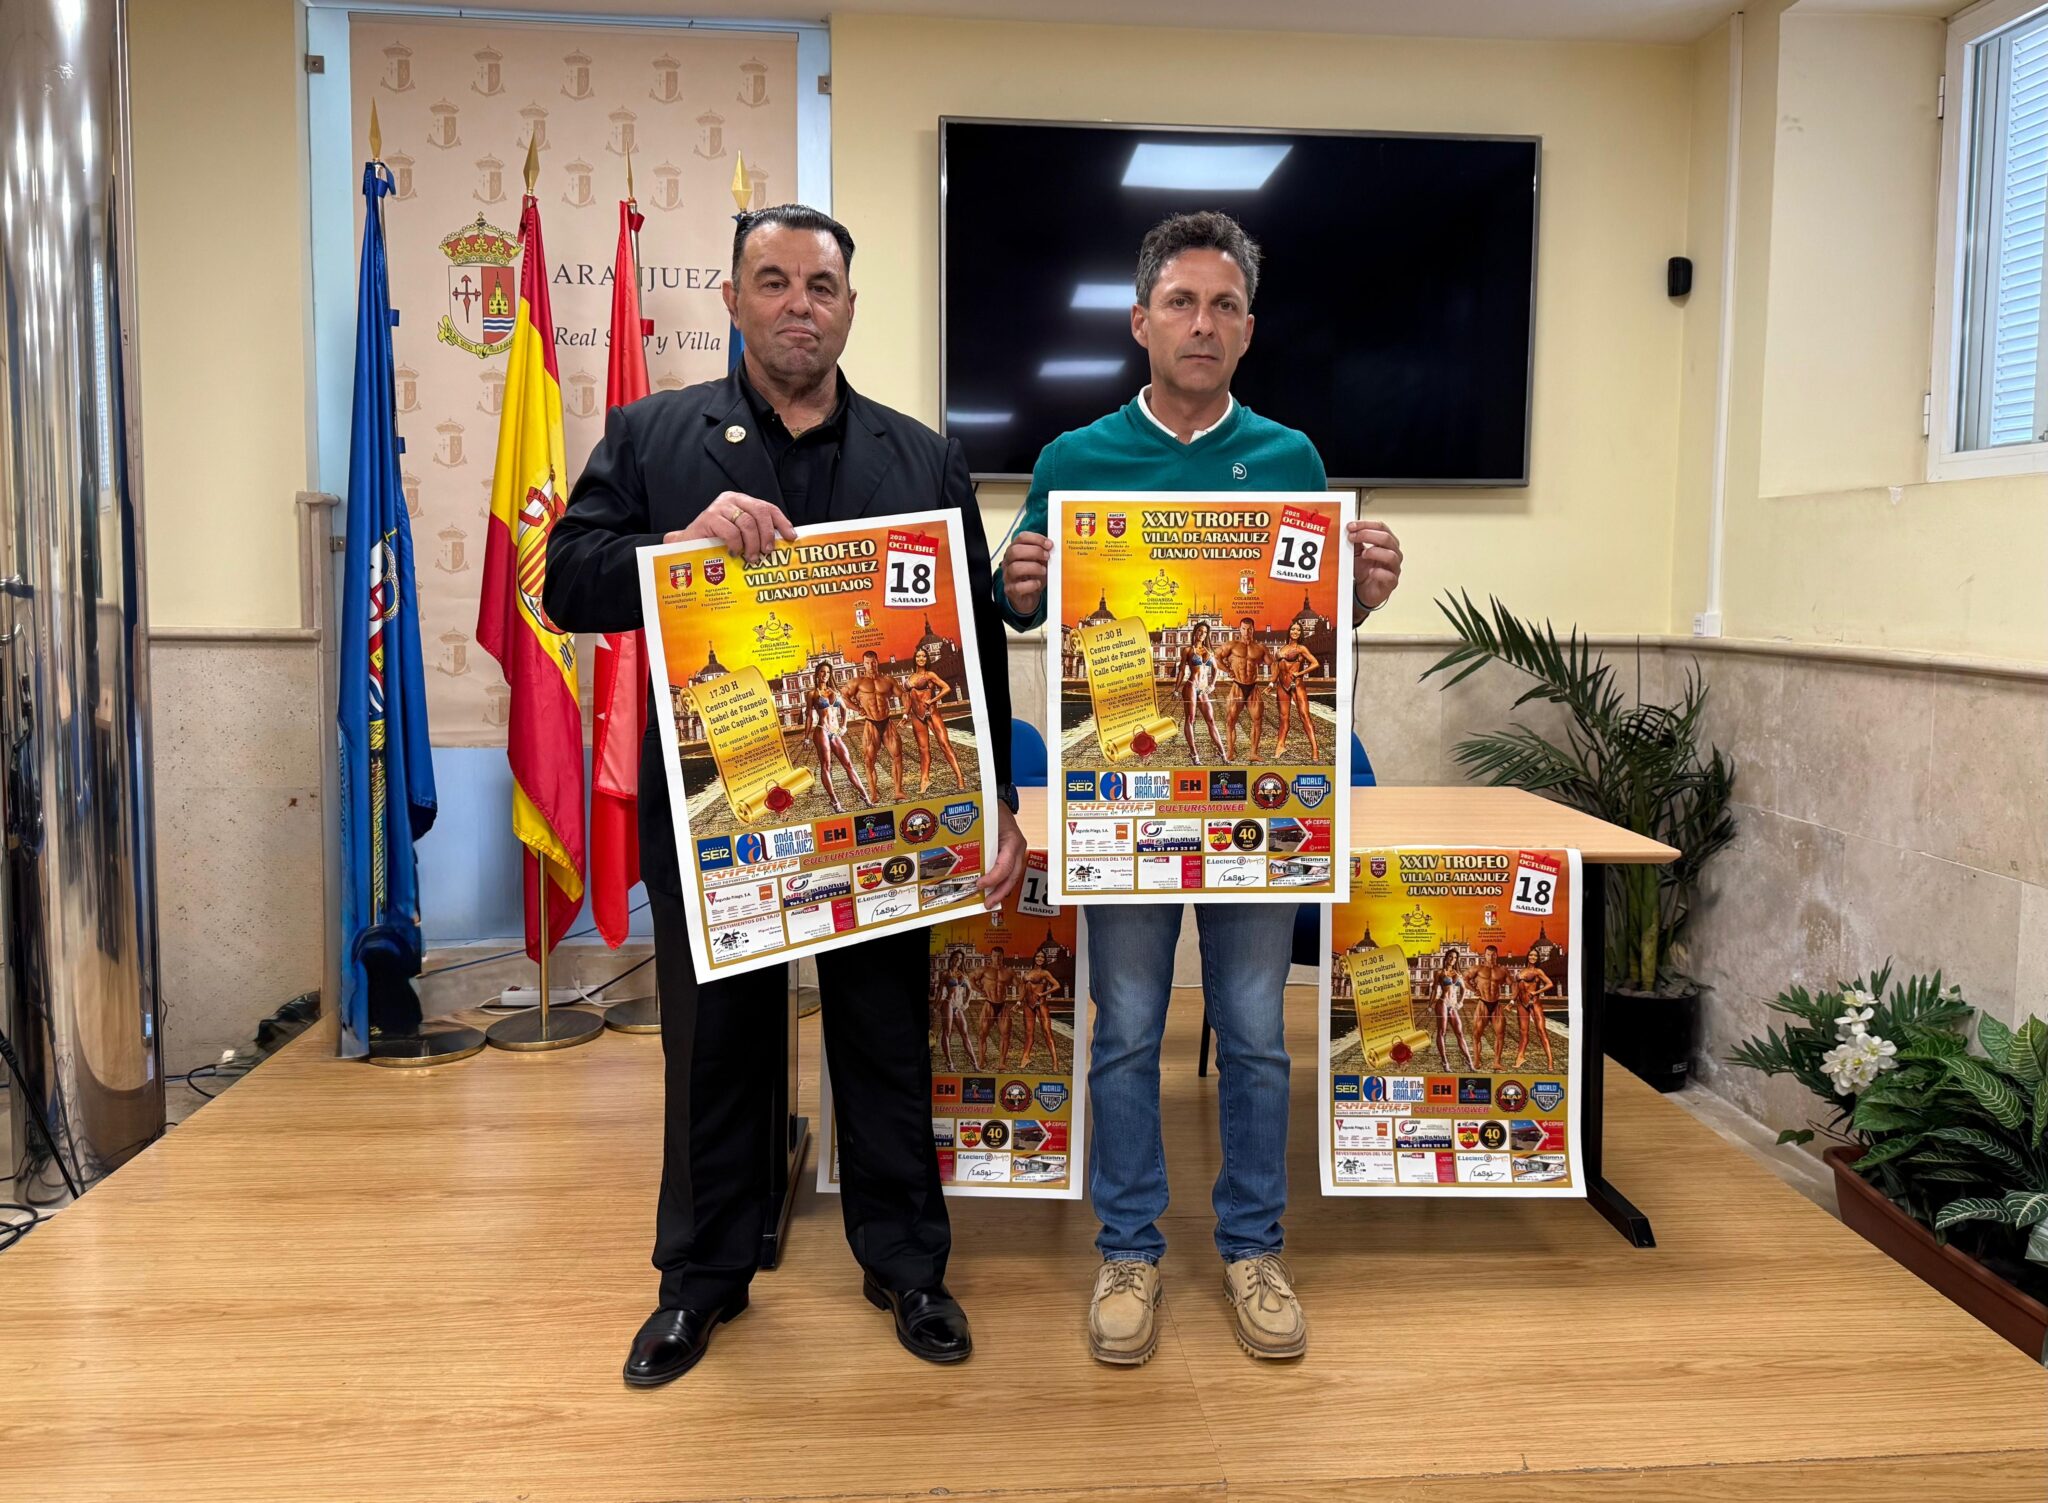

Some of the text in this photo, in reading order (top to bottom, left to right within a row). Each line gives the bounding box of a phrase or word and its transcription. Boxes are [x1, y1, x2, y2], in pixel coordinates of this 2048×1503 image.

[552, 263, 722, 292] ARAJUEZ
[555, 327, 597, 347] Real
[656, 336, 668, 355] y
[675, 331, 721, 350] Villa
[1143, 511, 1270, 527] XXIV TROFEO
[1285, 509, 1300, 518] 2025
[1282, 516, 1326, 533] OCTUBRE
[1143, 532, 1269, 543] VILLA DE ARANJUEZ
[743, 539, 876, 570] XIV TROFEO
[889, 543, 935, 554] OCTUBRE
[1150, 549, 1261, 559] JUANJO VILLAJOS
[1277, 537, 1318, 571] 18
[745, 560, 879, 586] VILLA DE ARANJUEZ
[890, 562, 931, 594] 18
[1276, 570, 1312, 580] SÁBADO
[757, 586, 809, 602] JUANJO
[811, 578, 873, 595] VILLAJOS
[891, 596, 928, 604] SÁBADO
[1095, 628, 1123, 643] 17.30 H
[1089, 637, 1136, 656] Centro cultural
[1091, 647, 1147, 667] Isabel de Farnesio
[1093, 658, 1146, 677] Calle Capitán, 39
[709, 680, 740, 699] 17.30 H
[705, 688, 755, 714] Centro cultural
[708, 697, 768, 725] Isabel de Farnesio
[713, 708, 769, 736] Calle Capitán, 39
[1134, 773, 1153, 785] onda
[1300, 777, 1323, 785] WORLD
[1068, 783, 1094, 792] SER
[1180, 780, 1202, 791] EH
[1134, 785, 1169, 799] ARANJUEZ
[1301, 790, 1322, 798] STRONG
[948, 804, 970, 814] WORLD
[1068, 802, 1154, 811] CAMPEONES
[1158, 804, 1245, 812] CULTURISMOWEB
[774, 829, 794, 844] onda
[823, 828, 847, 842] EH
[1239, 829, 1256, 839] 40
[775, 838, 814, 858] ARANJUEZ
[701, 848, 730, 862] SER
[1028, 859, 1049, 871] OCTU
[1400, 855, 1509, 869] XXIV TROFEO
[1519, 859, 1558, 873] OCTUBRE
[703, 858, 799, 881] CAMPEONES
[889, 864, 907, 876] 40
[1401, 873, 1509, 882] VILLA DE ARANJUEZ
[1407, 886, 1502, 896] JUANJO VILLAJOS
[1516, 877, 1551, 906] 18
[857, 892, 889, 903] E.Leclerc
[1023, 906, 1054, 915] SÁBADO
[1515, 904, 1547, 913] SÁBADO
[710, 919, 755, 932] REVESTIMIENTOS
[1360, 954, 1385, 967] 17.30 H
[1355, 962, 1396, 978] Centro cultural
[1357, 970, 1404, 986] Isabel de Farnesio
[1359, 987, 1372, 996] Calle
[1393, 1077, 1409, 1088] onda
[936, 1085, 955, 1095] EH
[1335, 1085, 1358, 1093] SER
[1393, 1089, 1424, 1100] ARANJUEZ
[1432, 1085, 1452, 1095] EH
[1335, 1102, 1411, 1110] CAMPEONES
[986, 1128, 1003, 1139] 40
[1484, 1129, 1500, 1139] 40
